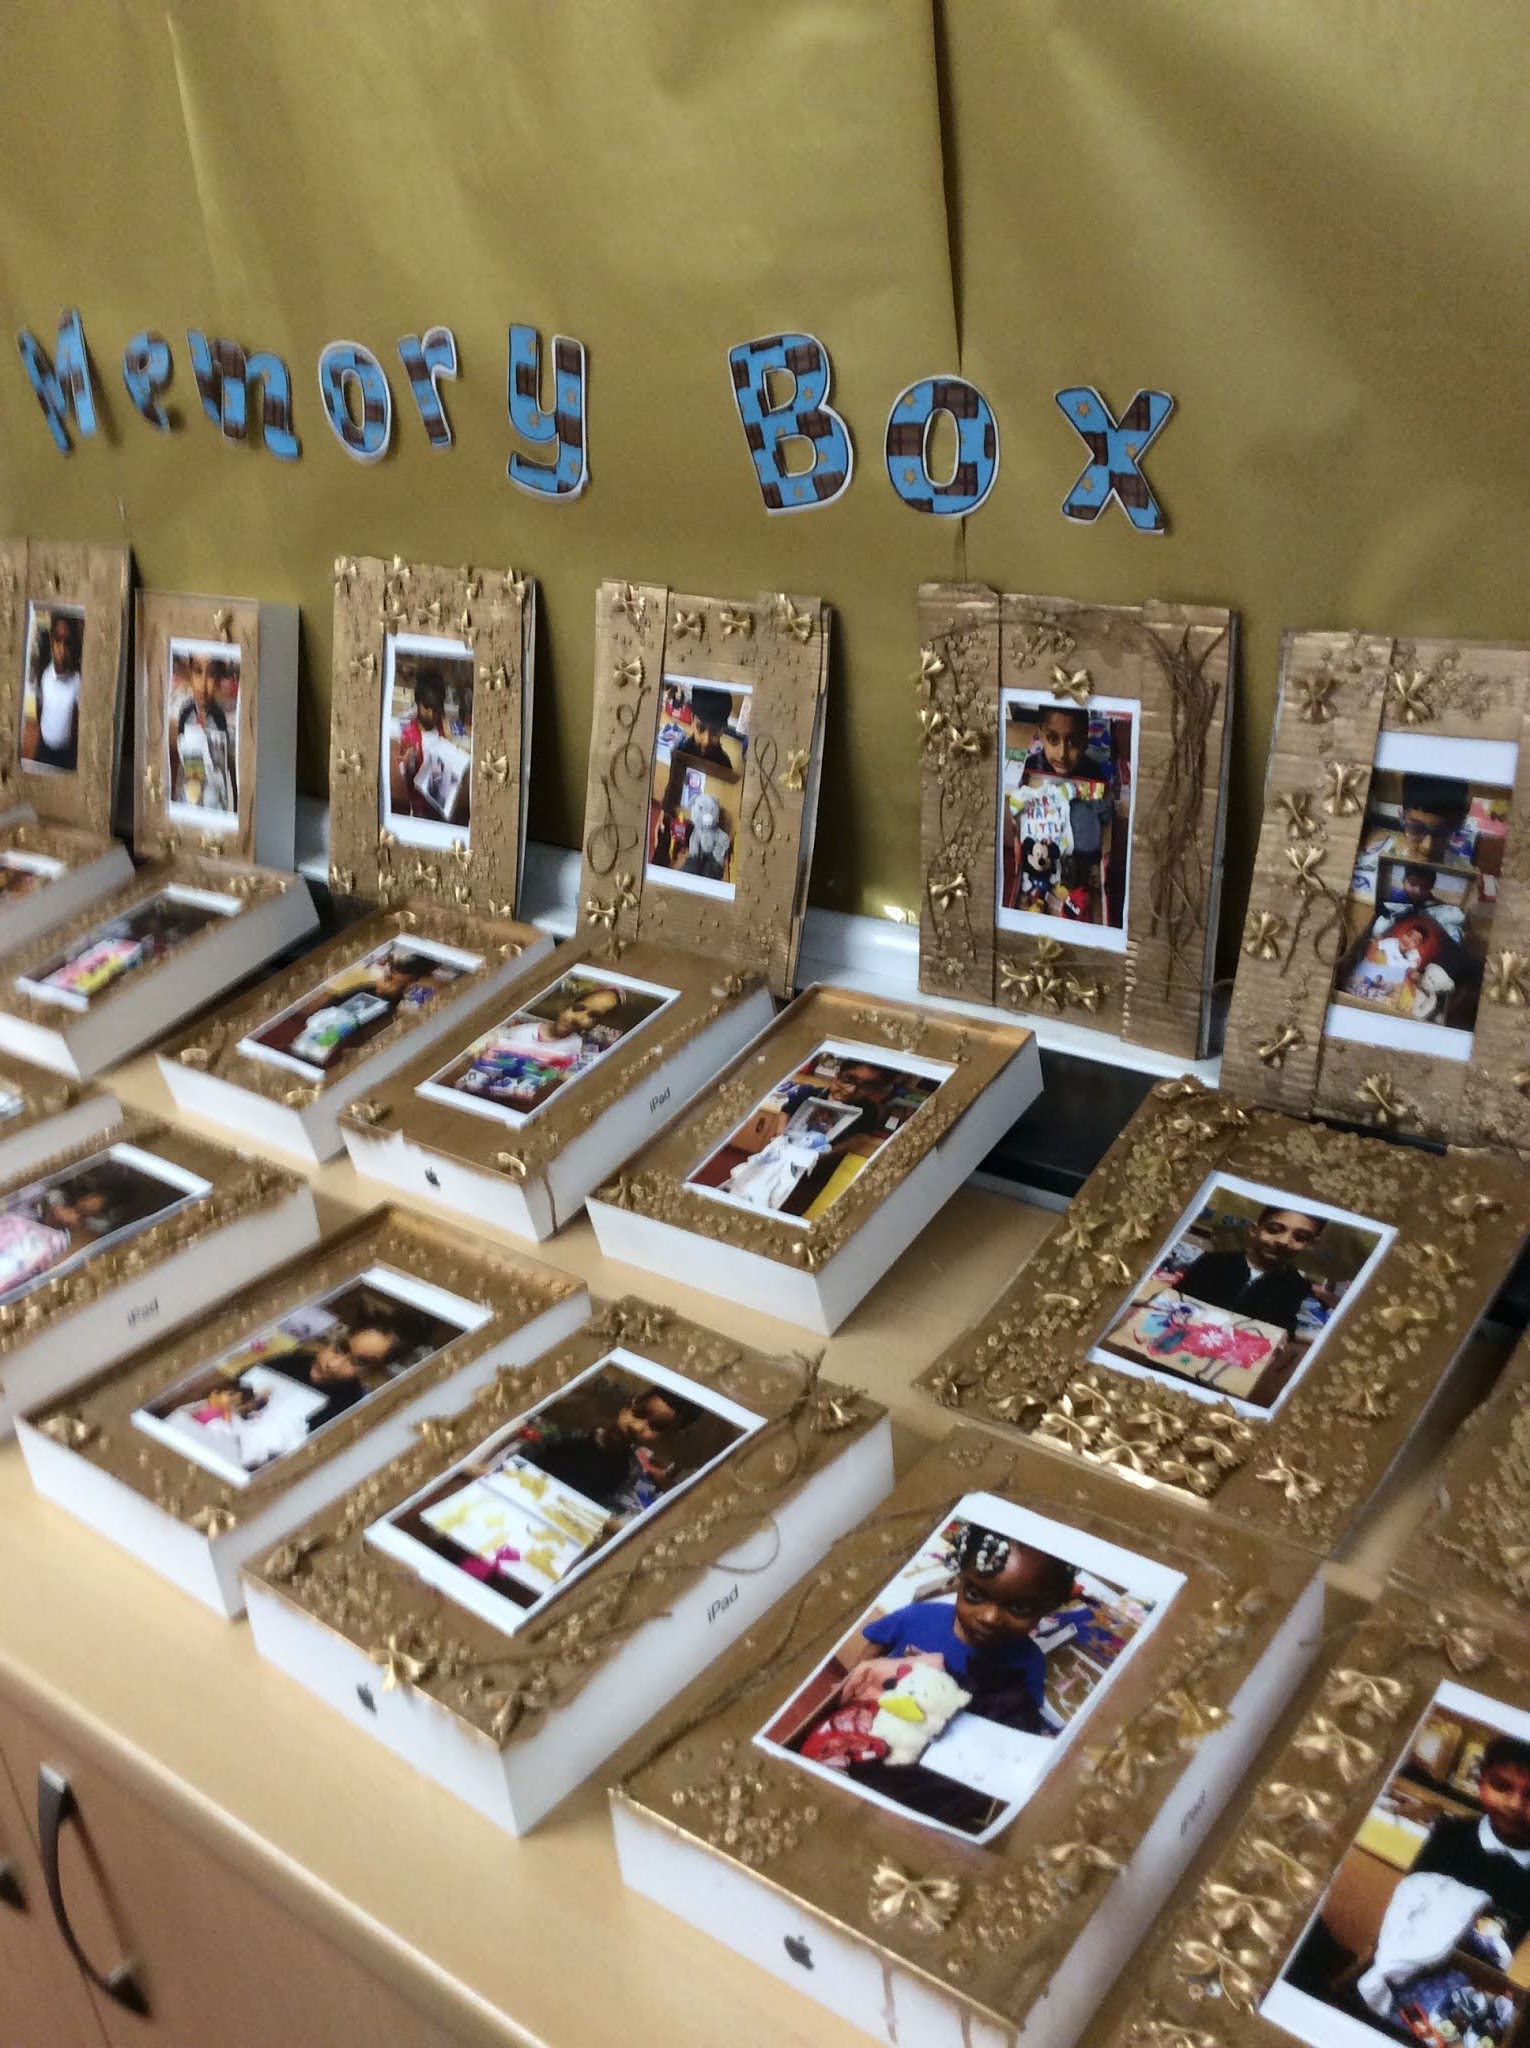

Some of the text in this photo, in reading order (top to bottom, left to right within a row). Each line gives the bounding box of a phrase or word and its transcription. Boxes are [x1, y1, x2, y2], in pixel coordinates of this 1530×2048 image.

[16, 307, 1174, 535] Memory Box
[650, 1087, 671, 1113] iPad
[127, 1297, 160, 1328] iPad
[707, 1583, 739, 1624] iPad
